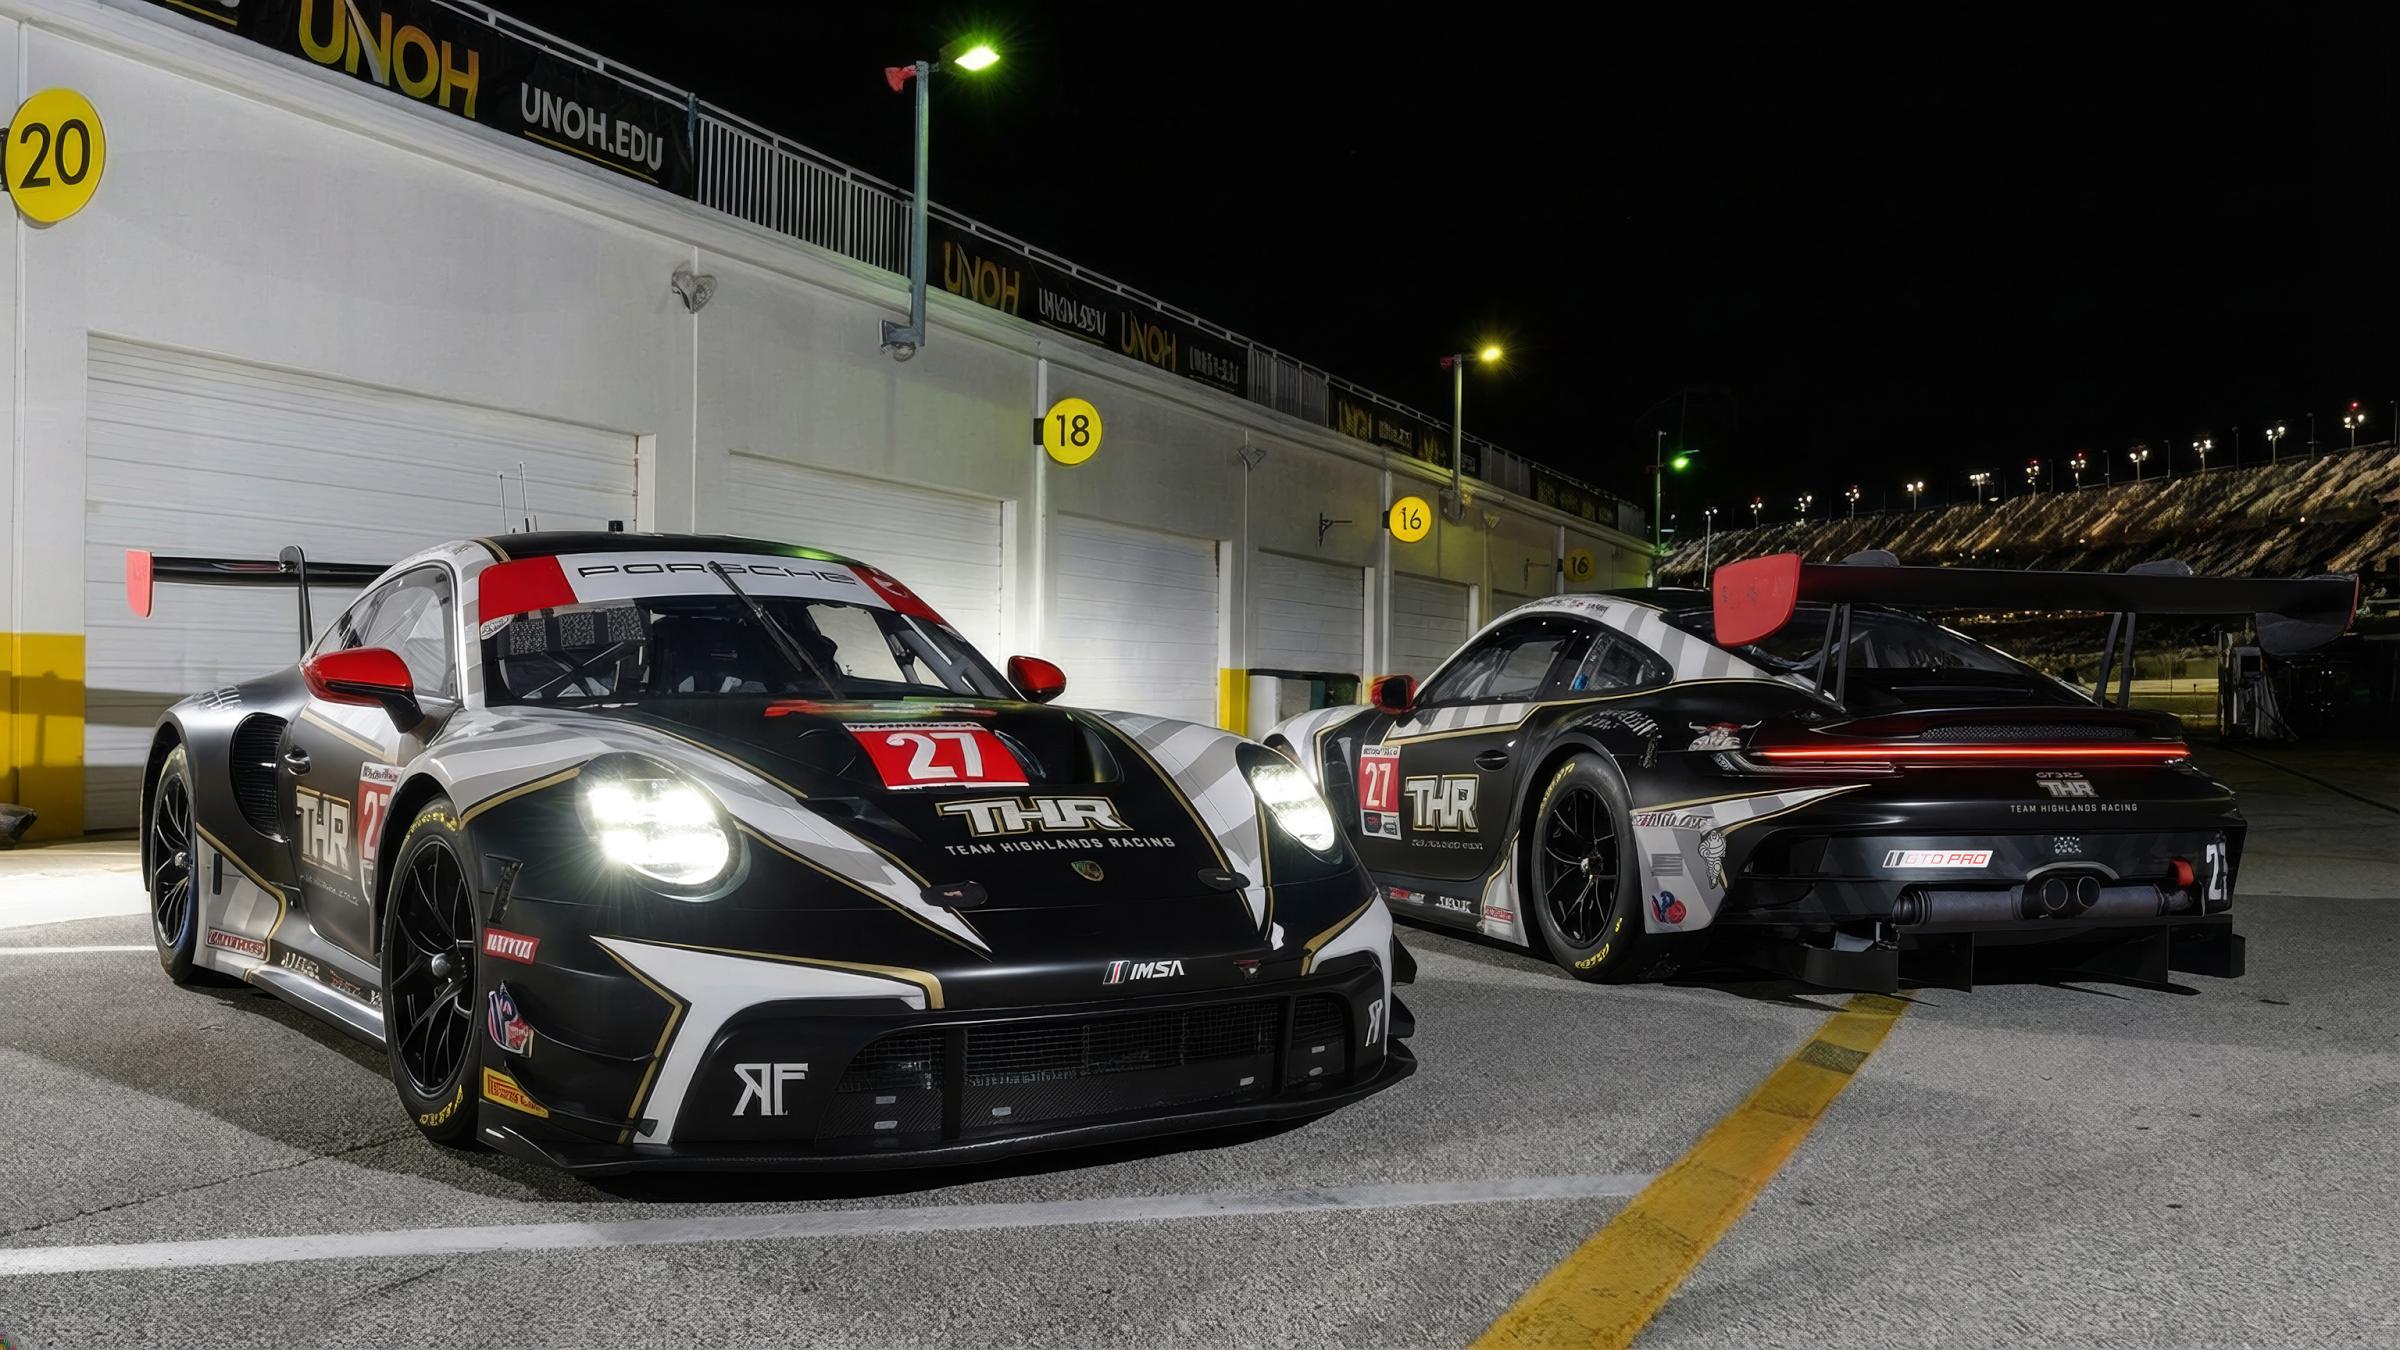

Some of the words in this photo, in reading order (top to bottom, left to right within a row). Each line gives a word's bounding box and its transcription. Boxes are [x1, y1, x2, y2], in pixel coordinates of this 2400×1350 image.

[299, 0, 479, 119] UNOH
[520, 82, 663, 172] UNOH.EDU
[19, 118, 91, 189] 20
[944, 241, 1020, 316] UNOH
[1056, 414, 1090, 447] 18
[1400, 507, 1422, 531] 16
[577, 563, 857, 585] PORSCHE
[886, 732, 983, 779] 27
[1365, 762, 1391, 808] 27
[1404, 774, 1480, 832] THR
[2036, 779, 2099, 798] THR
[936, 796, 1134, 837] THR
[2010, 804, 2037, 813] TEAM
[2041, 804, 2097, 813] HIGHLANDS
[2101, 803, 2138, 812] RACING
[296, 786, 351, 878] THR
[945, 844, 996, 856] TEAM
[1000, 837, 1103, 852] HIGHLANDS
[1108, 836, 1176, 848] RACING
[1904, 853, 1944, 865] GTD
[1946, 853, 1989, 865] PRO
[1129, 960, 1185, 981] IMSA
